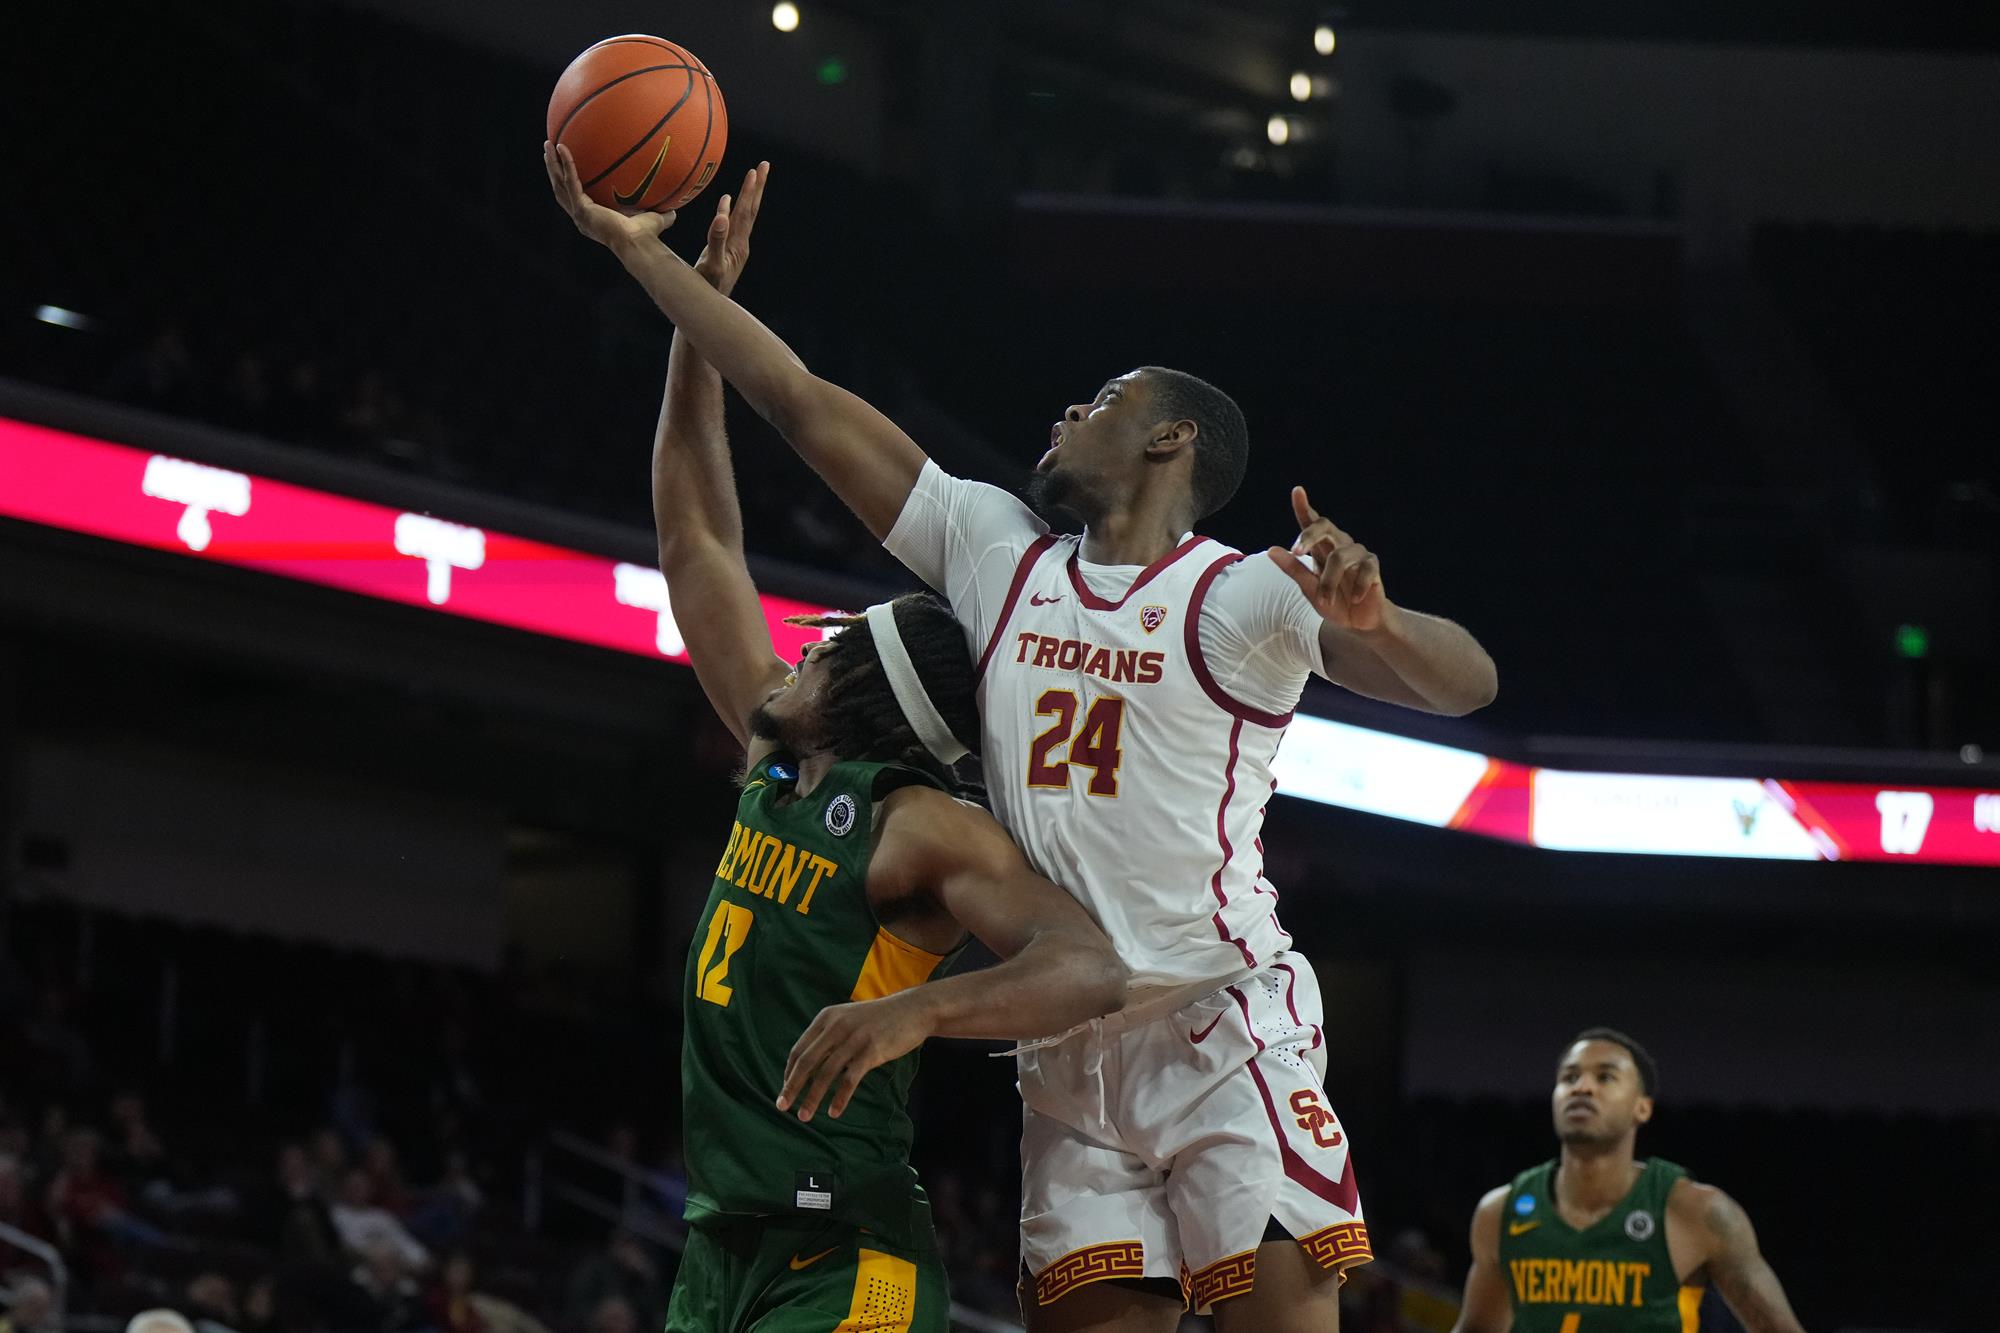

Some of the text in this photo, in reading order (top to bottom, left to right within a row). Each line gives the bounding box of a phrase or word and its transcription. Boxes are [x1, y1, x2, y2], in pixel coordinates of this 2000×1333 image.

[1145, 617, 1158, 628] 12
[1027, 688, 1125, 798] 24
[696, 900, 754, 1007] 12
[1288, 1089, 1342, 1149] SC
[809, 1177, 819, 1188] L
[1510, 1259, 1649, 1307] VERMONT
